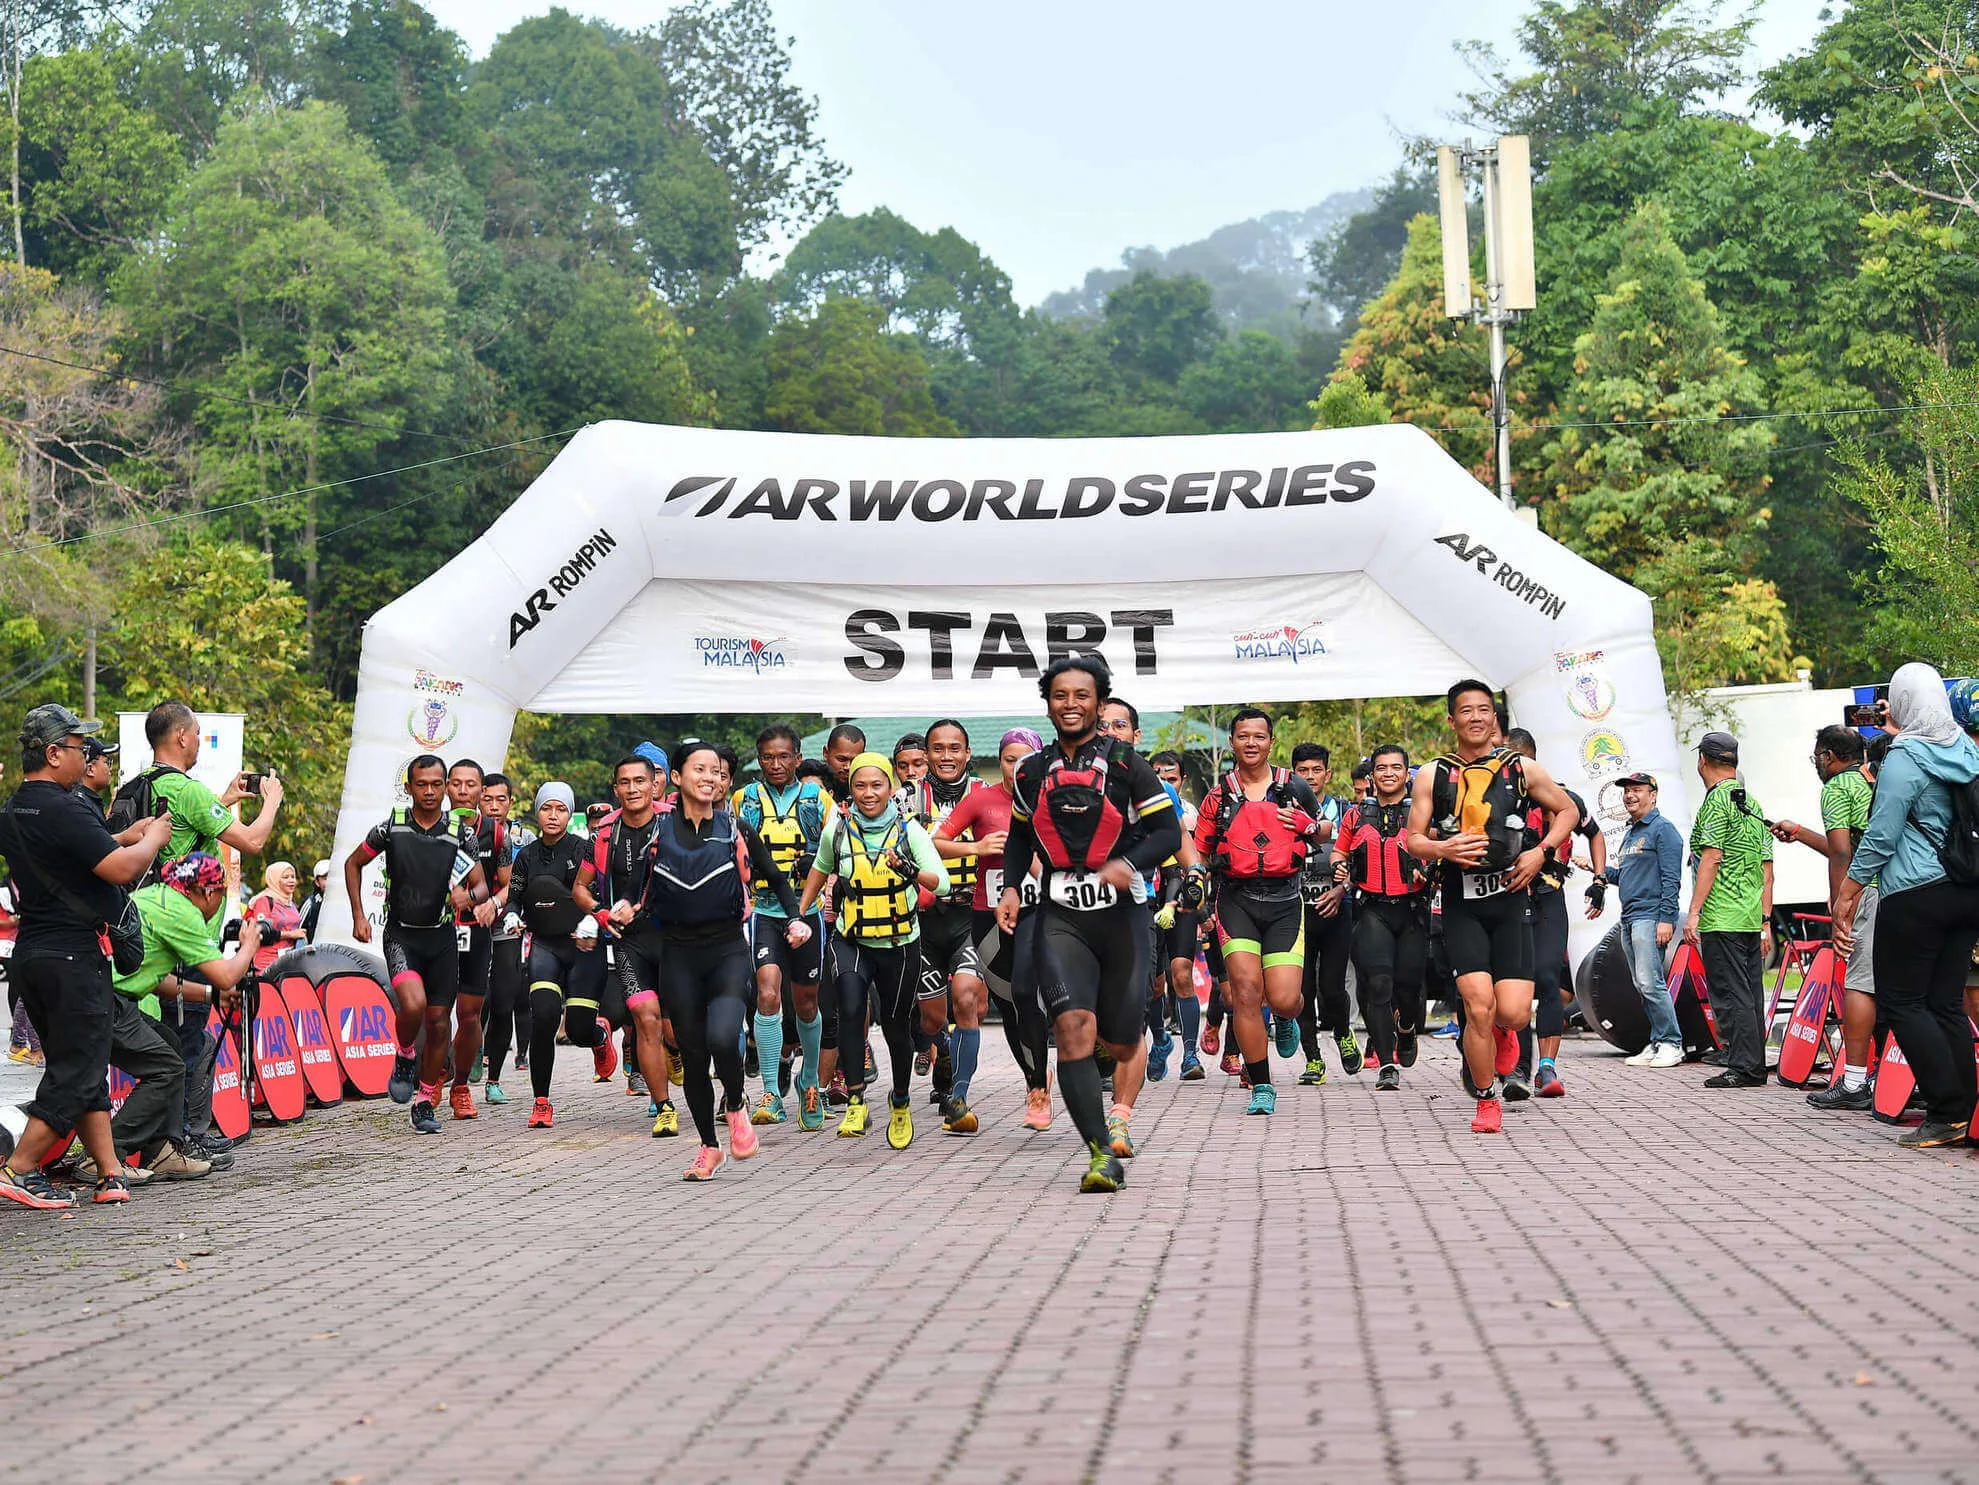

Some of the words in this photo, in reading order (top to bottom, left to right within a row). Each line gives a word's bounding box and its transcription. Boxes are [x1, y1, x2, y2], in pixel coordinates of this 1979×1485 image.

[1433, 533, 1498, 575] AR
[509, 588, 558, 650] AR
[694, 637, 751, 650] TOURISM
[843, 608, 1175, 682] START
[1235, 638, 1326, 664] MALAYSIA
[704, 651, 785, 675] MALAYSIA
[1063, 883, 1113, 908] 304
[345, 1044, 366, 1059] ASIA
[367, 1042, 396, 1057] SERIES
[261, 1063, 276, 1079] ASIA
[275, 1059, 296, 1077] SERIES
